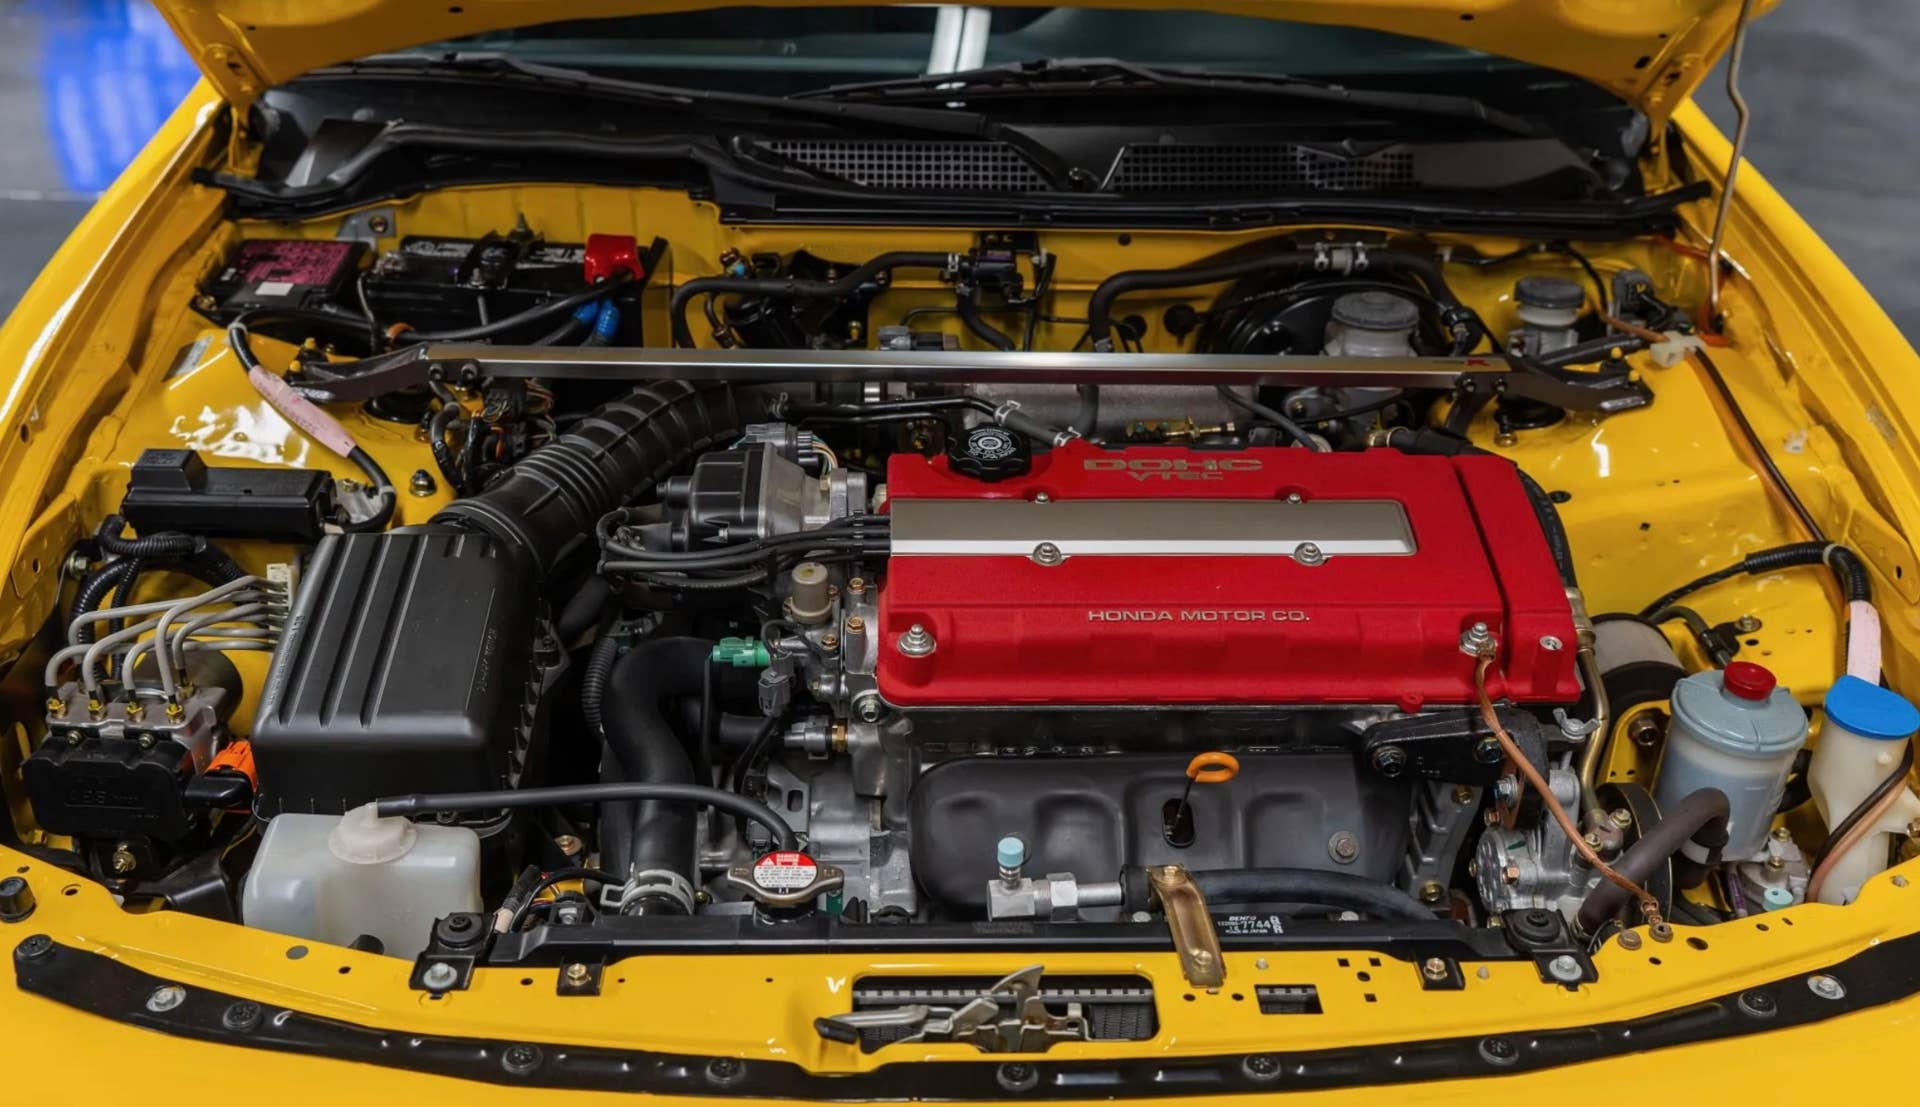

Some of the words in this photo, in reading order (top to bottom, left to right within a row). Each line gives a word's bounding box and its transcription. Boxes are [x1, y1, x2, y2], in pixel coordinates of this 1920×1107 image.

[1083, 459, 1263, 471] DOHC
[1127, 471, 1224, 481] VTEC
[1088, 610, 1173, 621] HONDA
[1180, 610, 1267, 621] MOTOR
[1271, 610, 1311, 621] CO.
